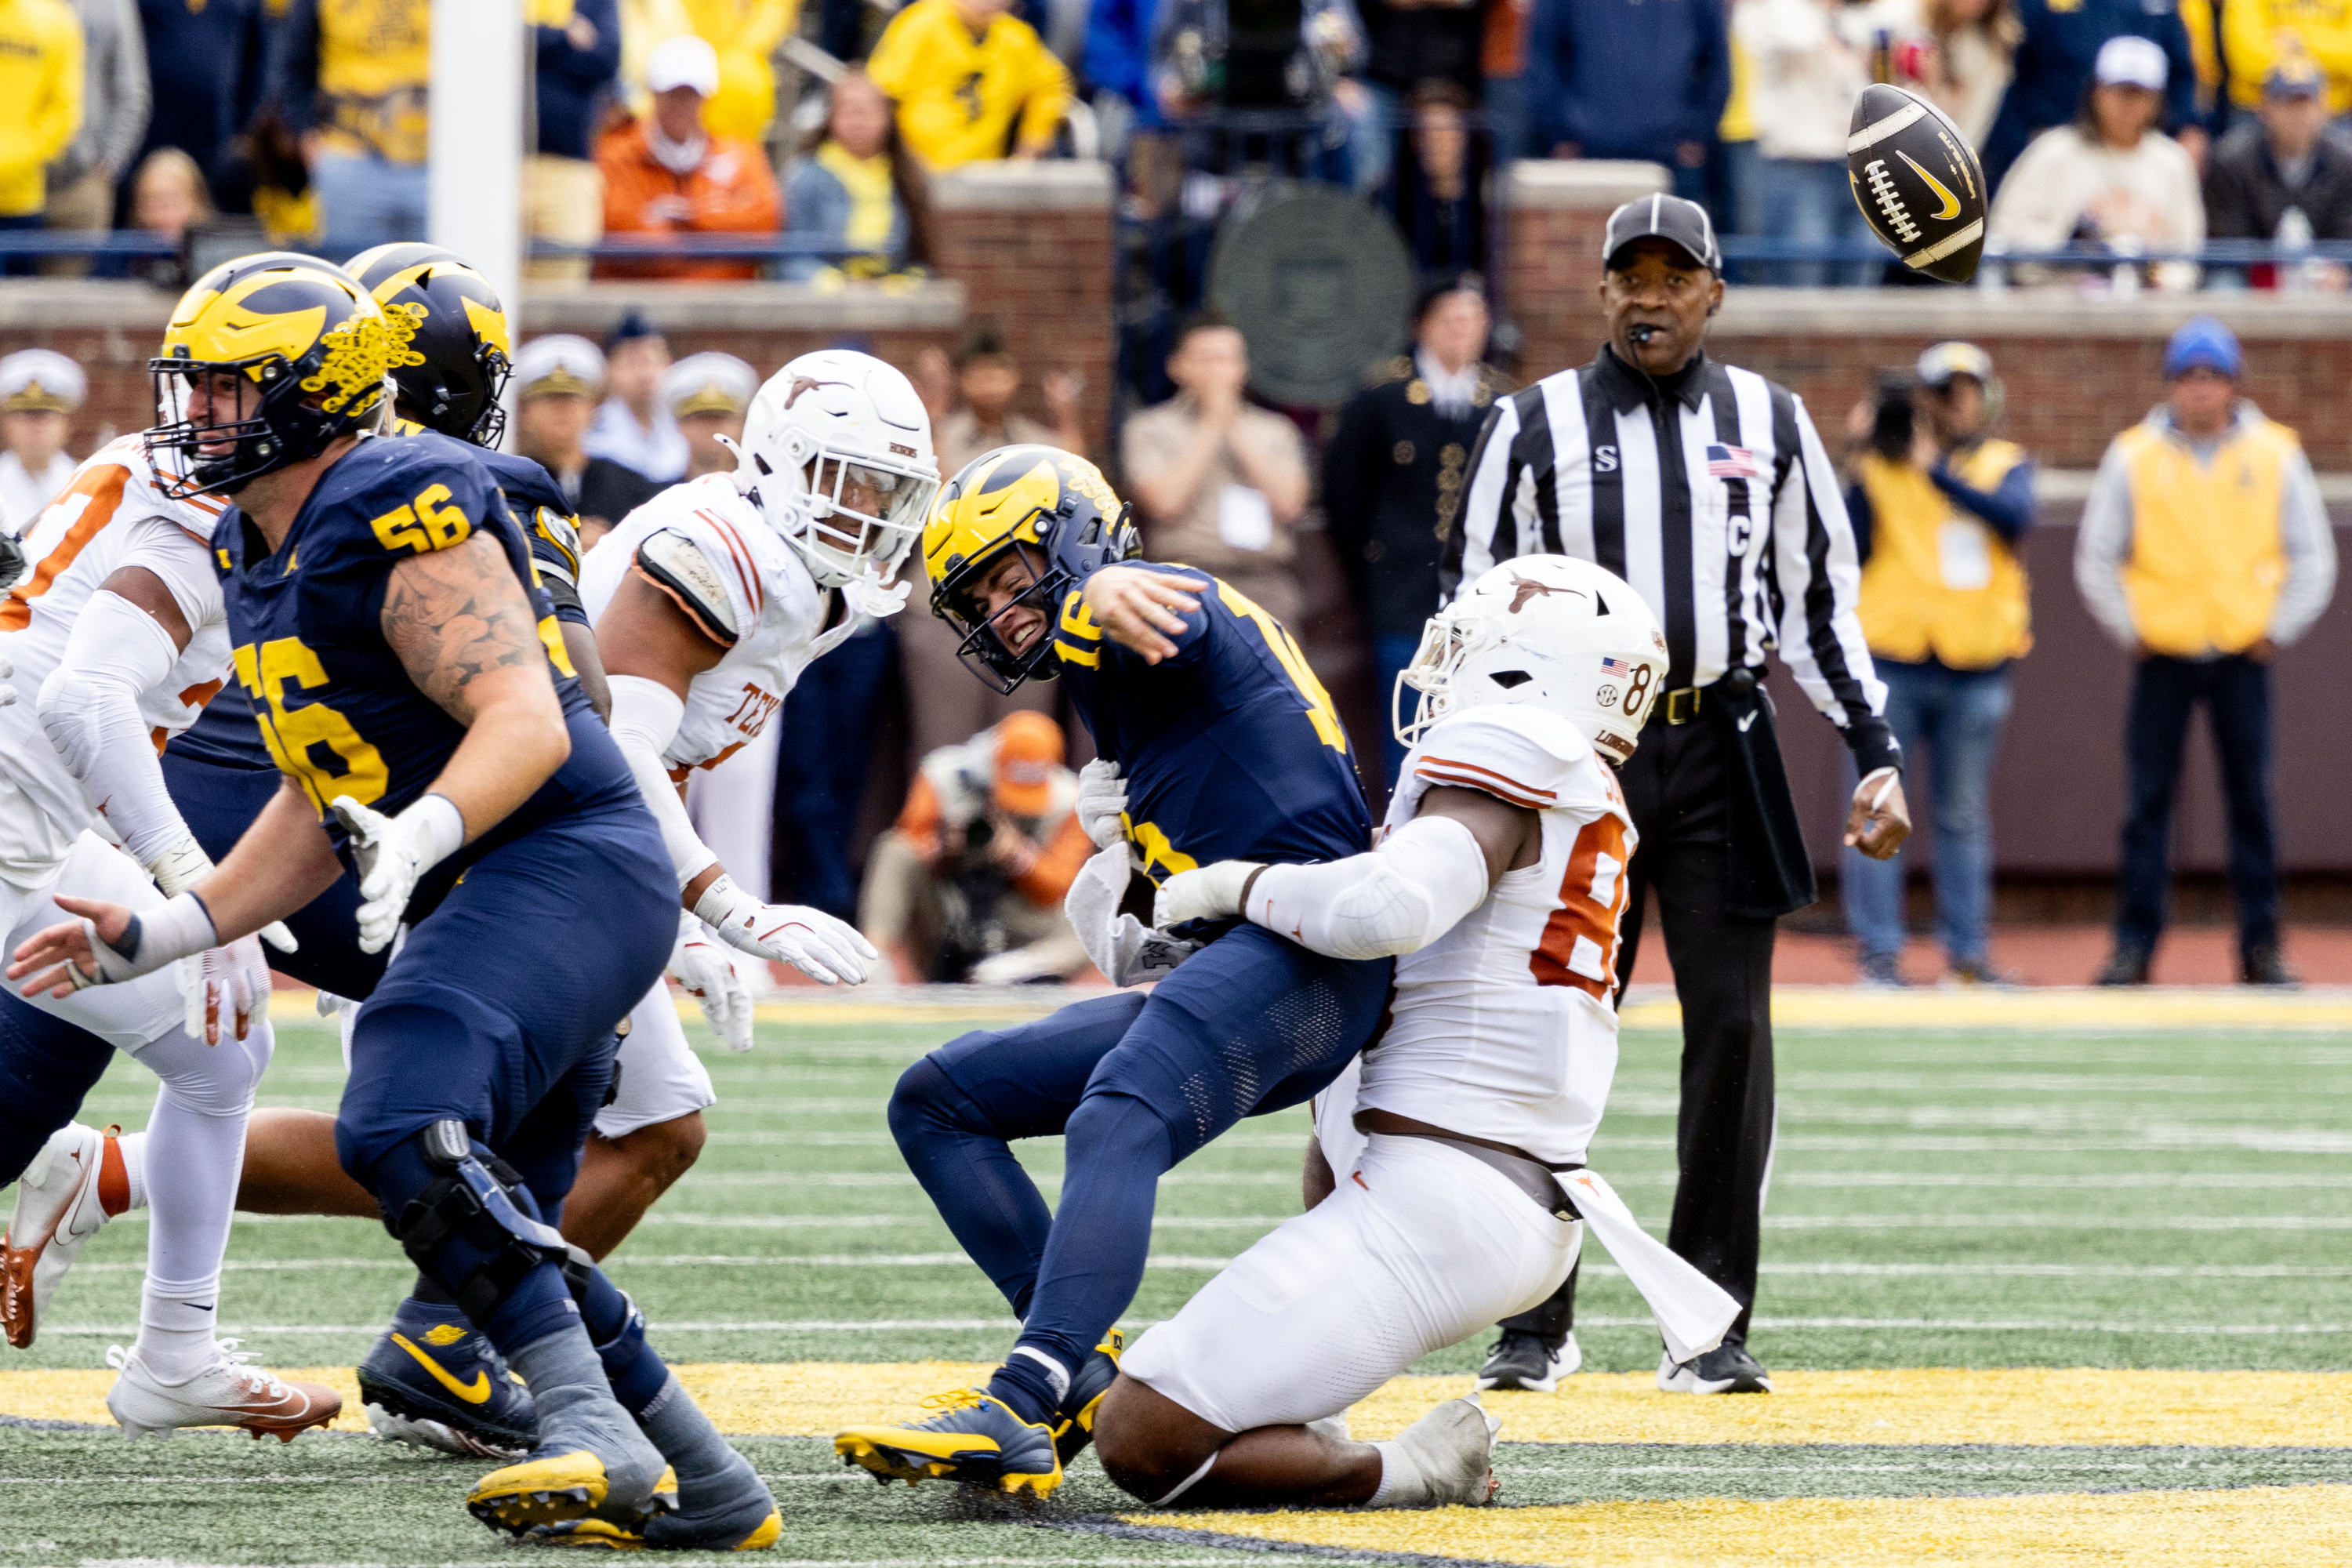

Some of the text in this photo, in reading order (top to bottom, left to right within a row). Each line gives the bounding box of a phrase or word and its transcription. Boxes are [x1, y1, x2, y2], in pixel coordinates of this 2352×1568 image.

[1595, 445, 1618, 472] S
[370, 483, 470, 554] 56
[1728, 515, 1751, 557] C
[1054, 590, 1102, 671] 16
[724, 681, 784, 738] TEX
